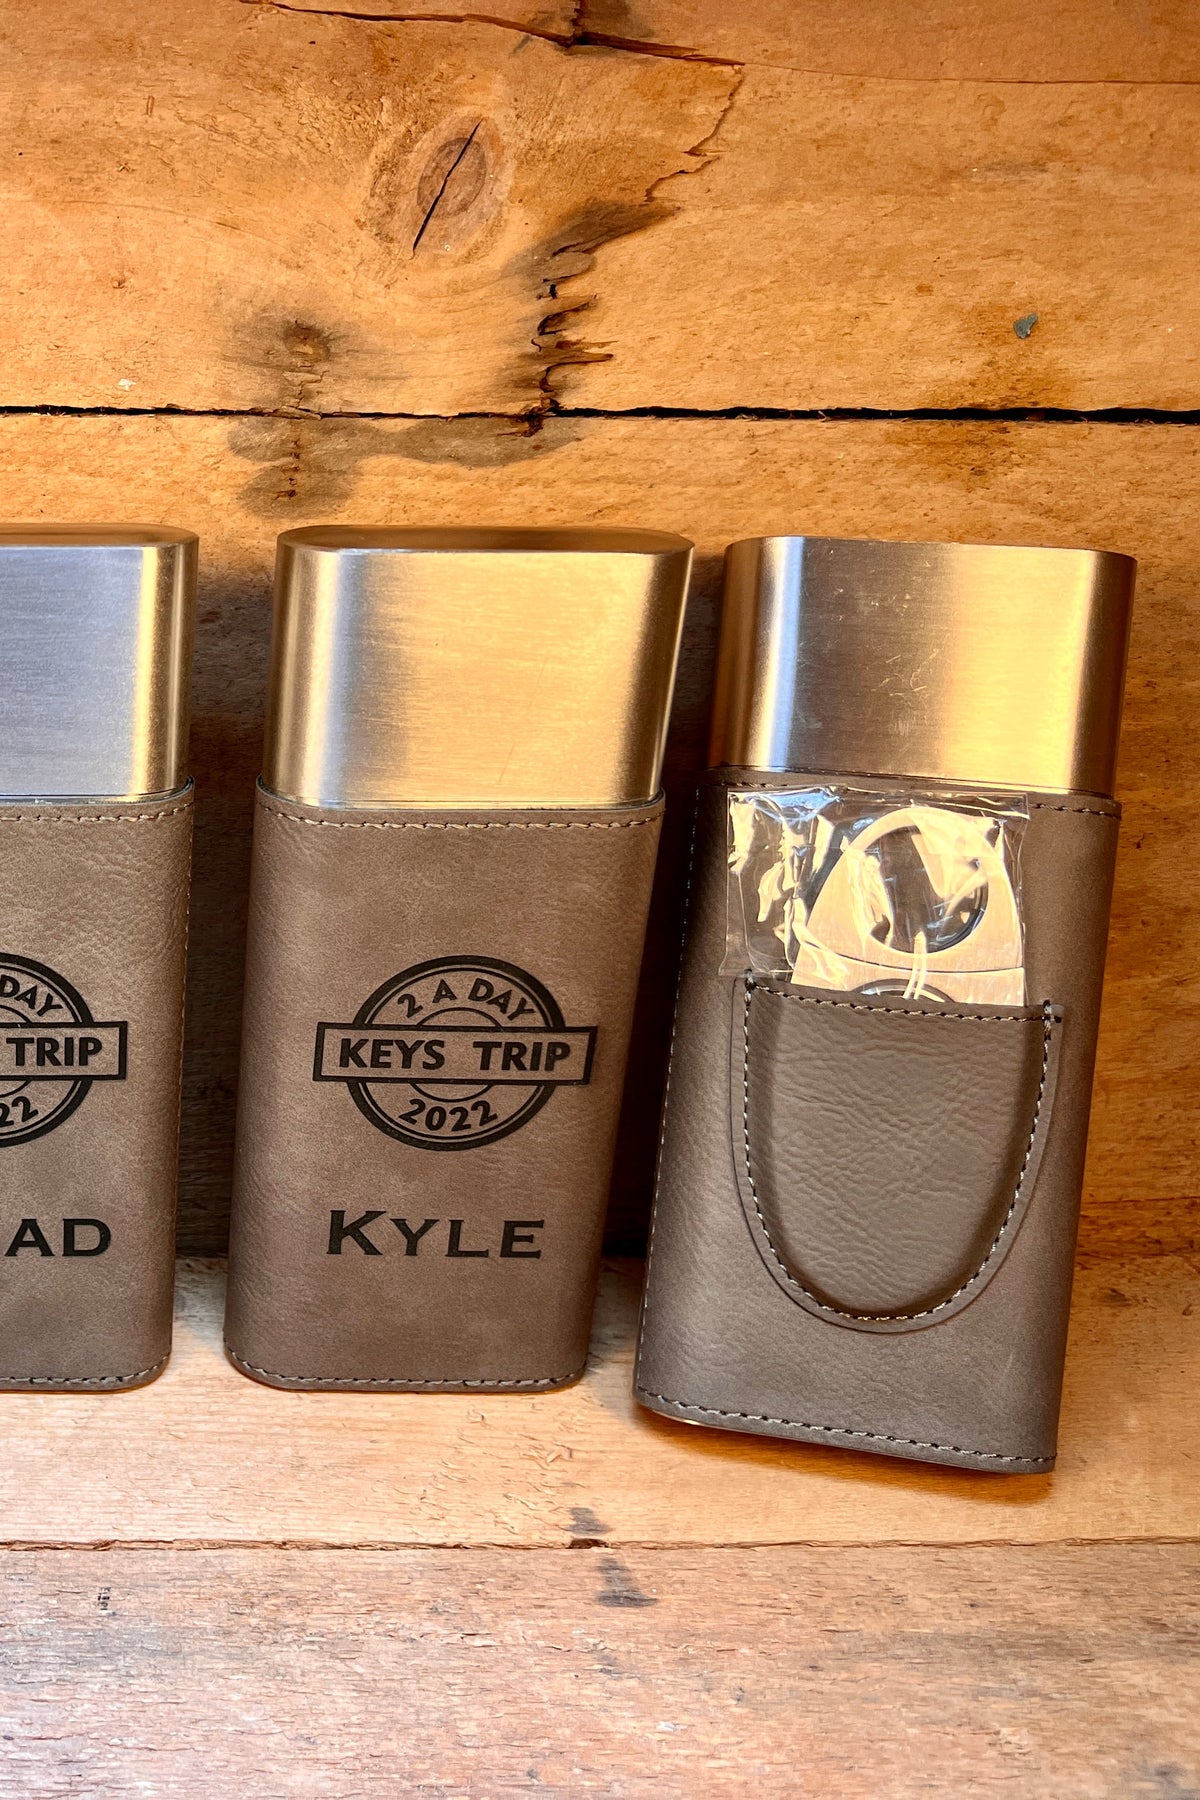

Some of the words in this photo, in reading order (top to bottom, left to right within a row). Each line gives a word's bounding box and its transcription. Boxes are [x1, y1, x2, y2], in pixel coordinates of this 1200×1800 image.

[397, 993, 423, 1018] 2
[432, 979, 457, 1003] A
[468, 978, 535, 1021] DAY
[6, 1036, 103, 1067] TRIP
[338, 1038, 446, 1070] KEYS
[472, 1041, 571, 1072] TRIP
[398, 1098, 498, 1132] 2022
